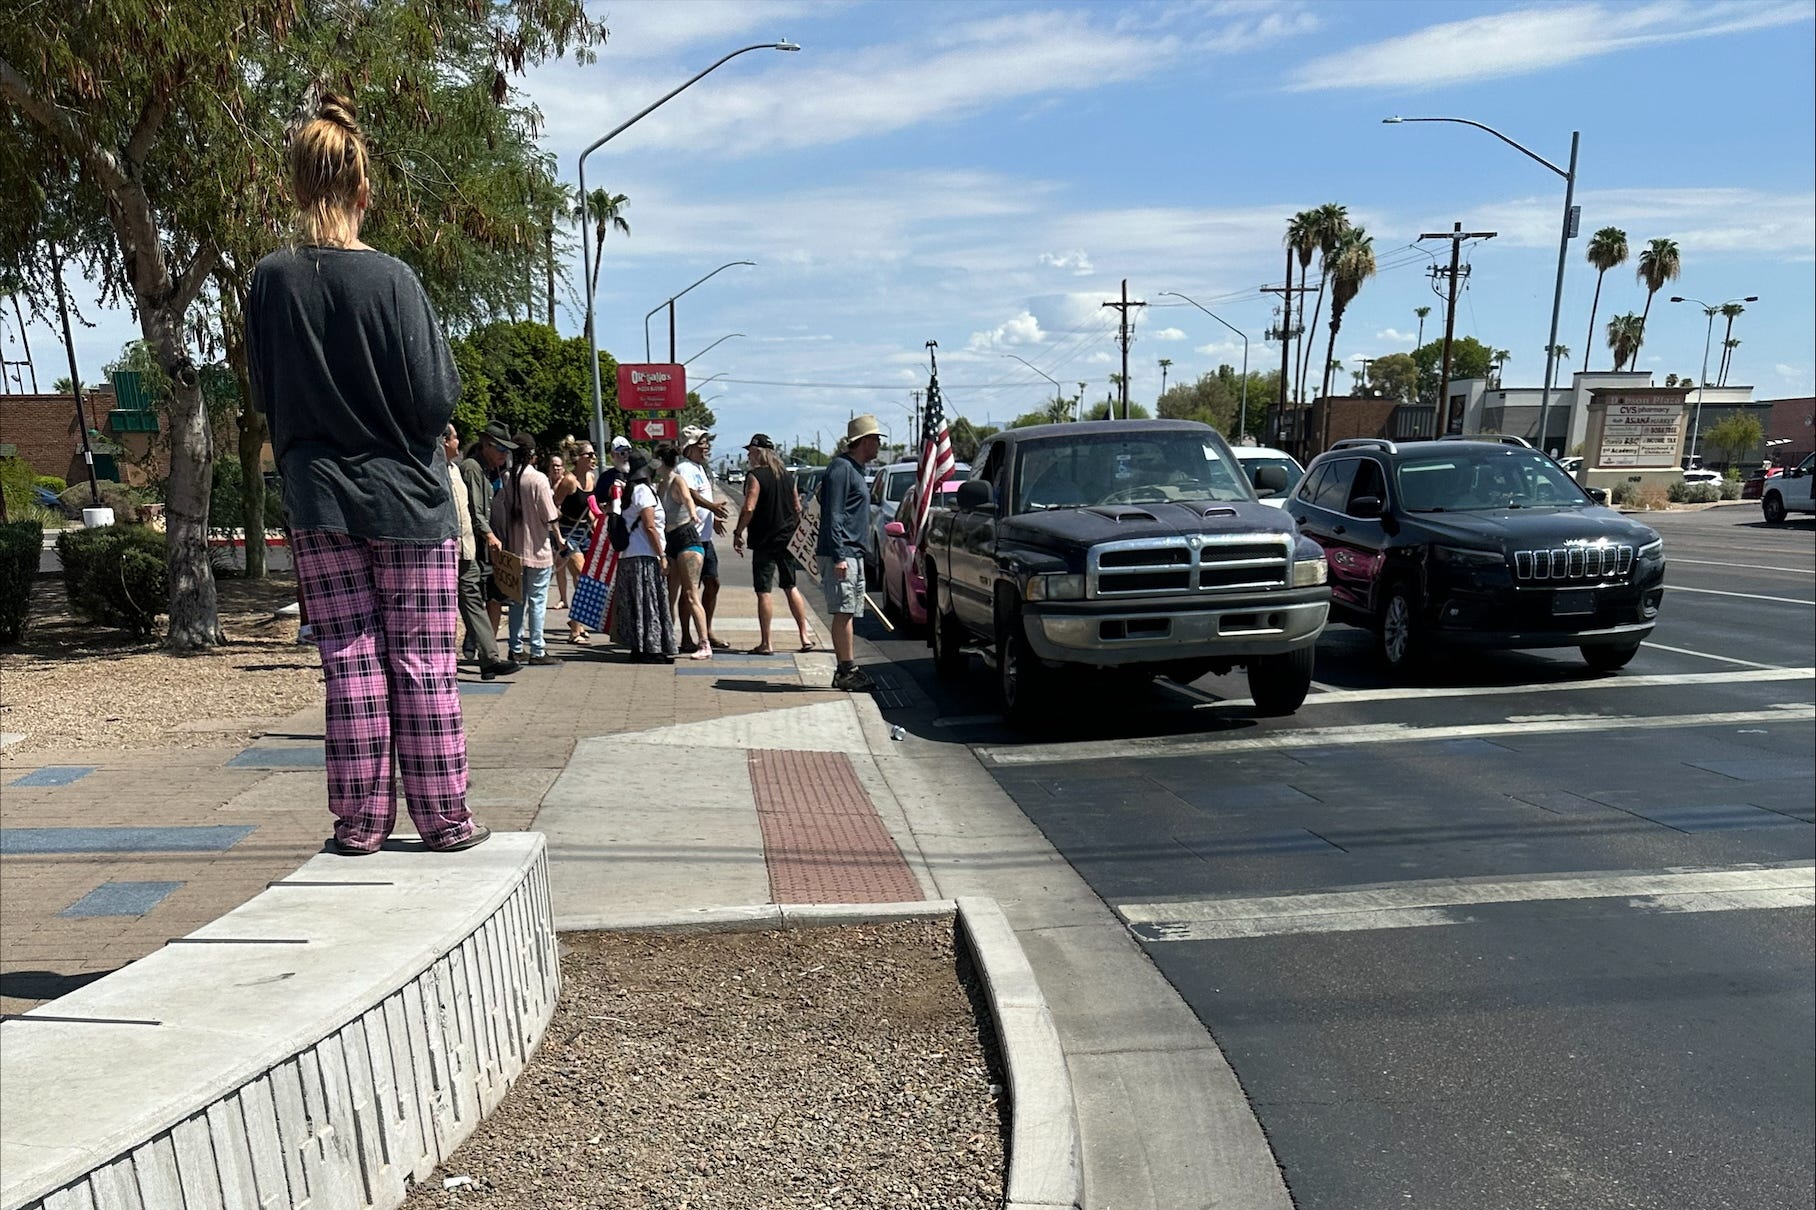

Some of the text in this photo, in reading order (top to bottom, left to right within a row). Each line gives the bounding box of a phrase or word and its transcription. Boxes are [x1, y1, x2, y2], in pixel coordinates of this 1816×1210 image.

[1620, 406, 1670, 414] CVS pharmacy
[791, 526, 807, 553] ICE
